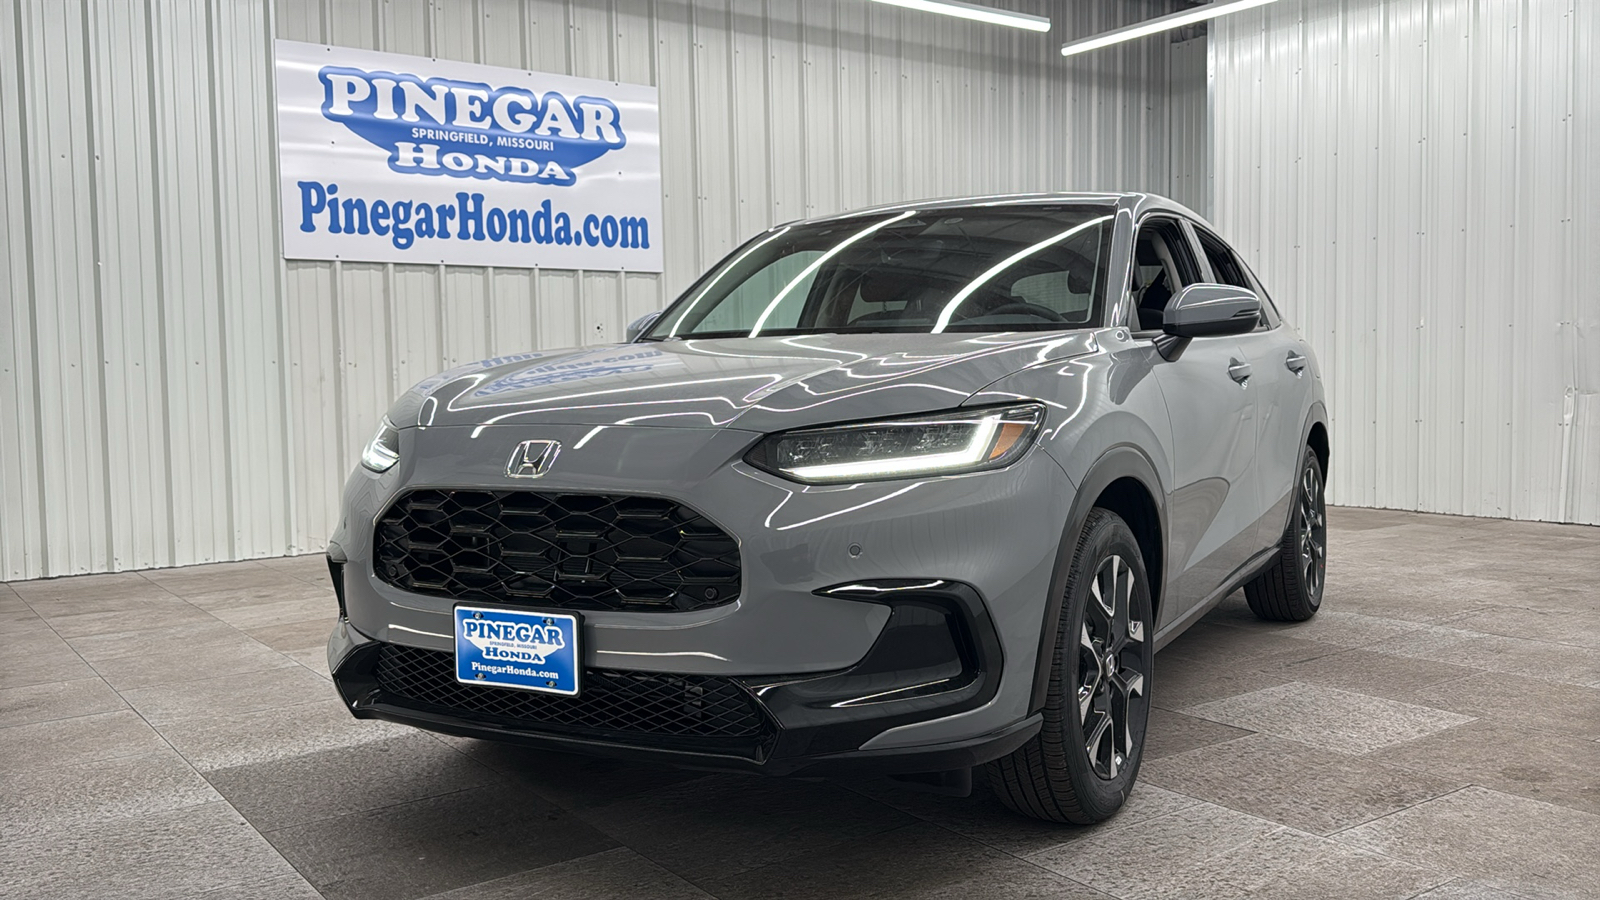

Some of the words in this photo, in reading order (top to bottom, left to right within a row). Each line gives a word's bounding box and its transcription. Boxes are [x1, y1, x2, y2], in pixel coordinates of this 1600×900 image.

[324, 73, 622, 143] PINEGAR
[411, 127, 494, 147] SPRINGFIELD,
[496, 136, 554, 152] MISSOURI
[394, 141, 571, 180] HONDA
[297, 181, 650, 250] PinegarHonda.com
[464, 621, 563, 646] PINEGAR
[484, 646, 543, 662] HONDA
[471, 662, 559, 679] PinegarHonda.com
